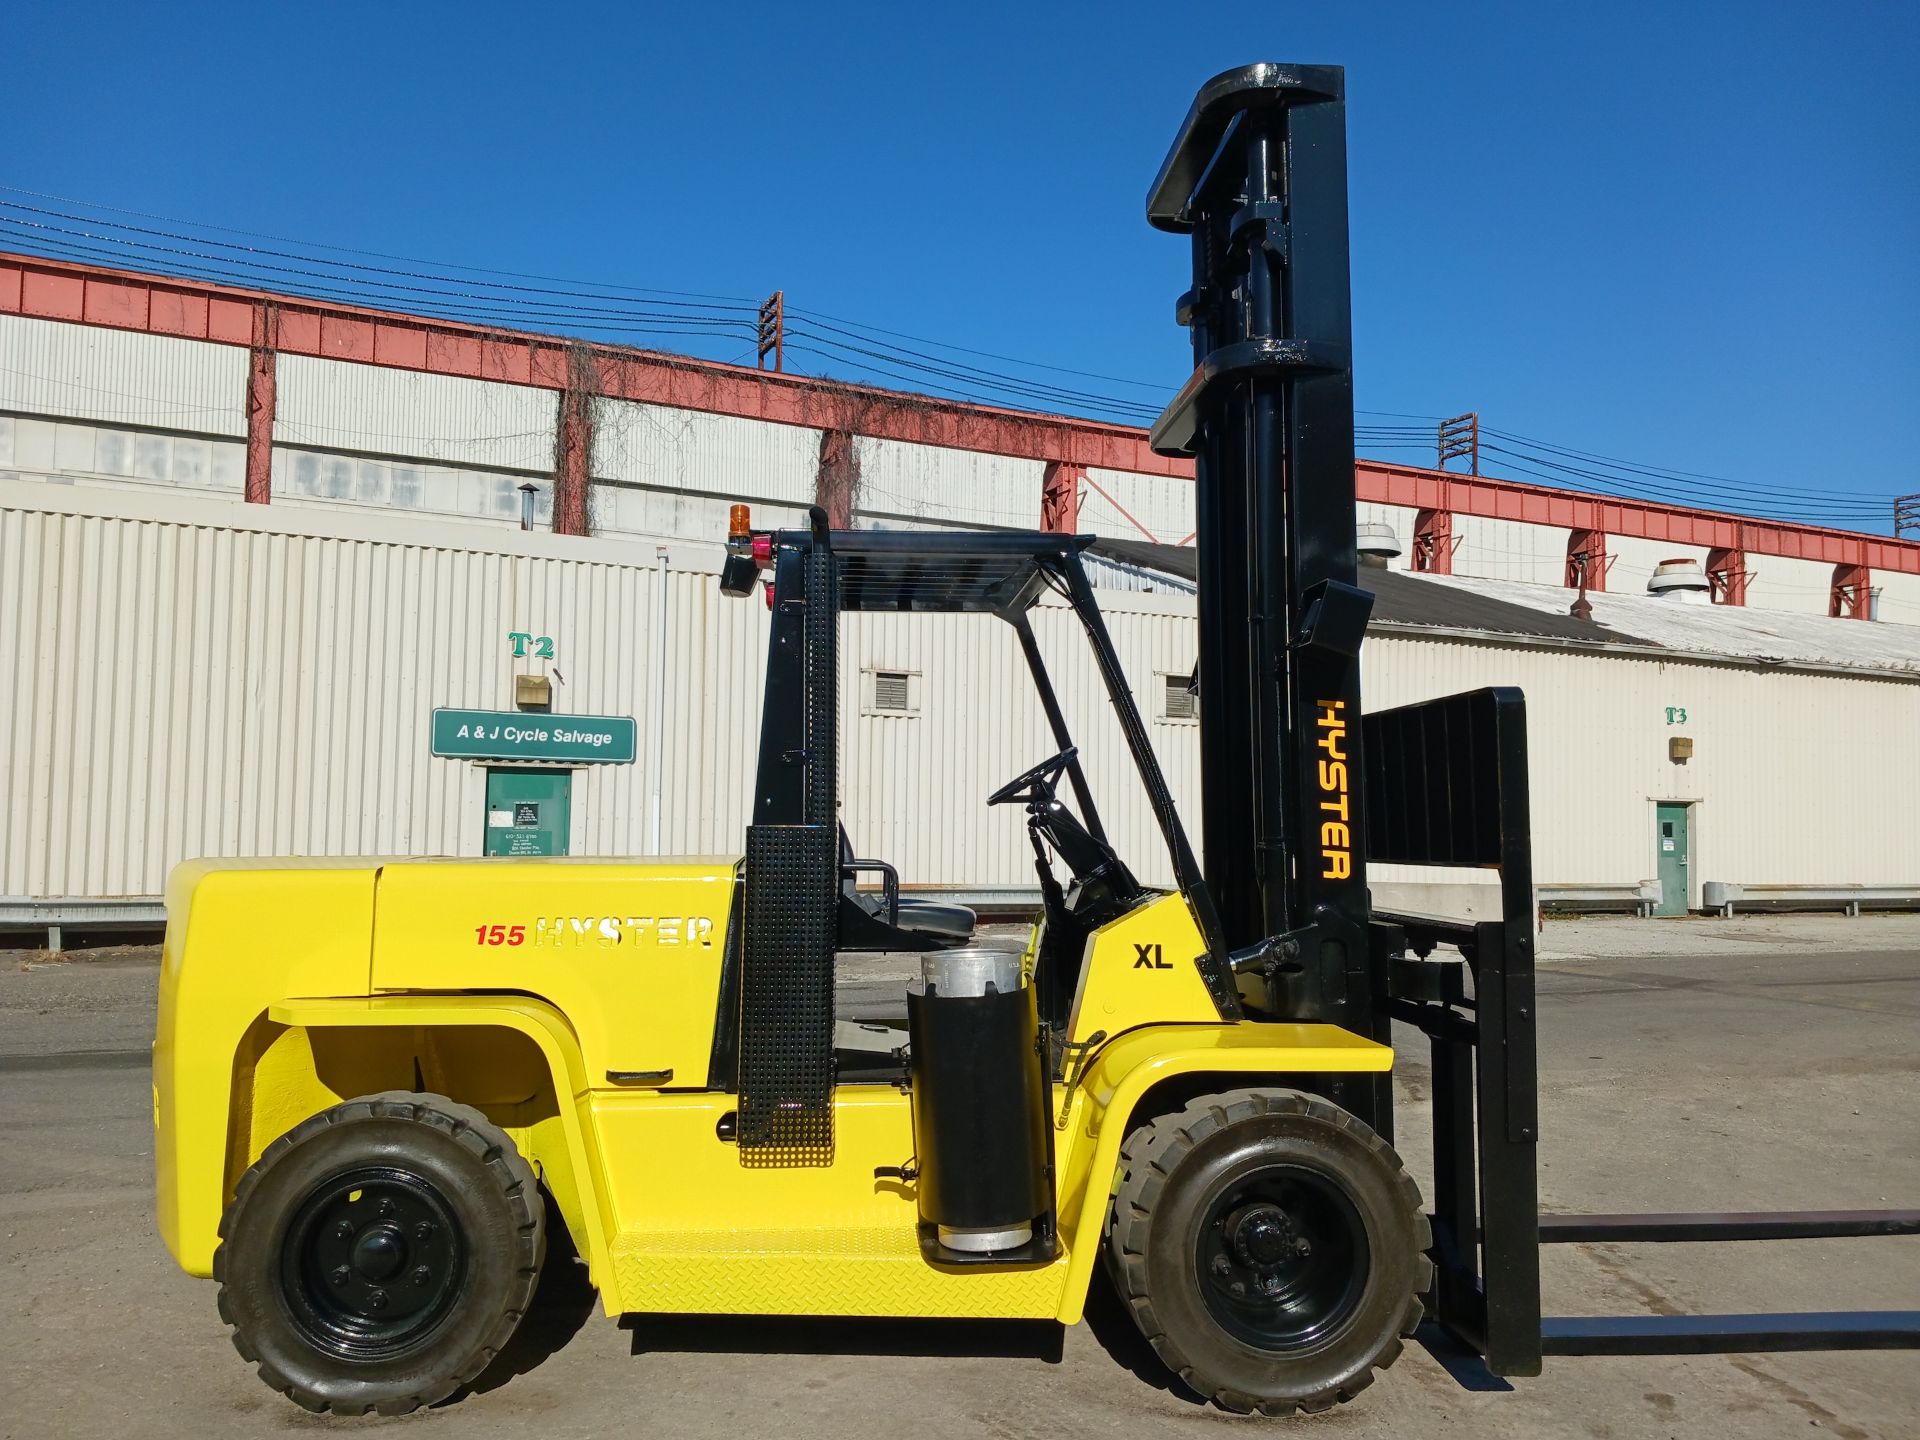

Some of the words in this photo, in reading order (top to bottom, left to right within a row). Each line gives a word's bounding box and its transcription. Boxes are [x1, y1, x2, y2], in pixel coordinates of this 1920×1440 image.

[508, 631, 554, 659] T2
[1665, 706, 1687, 724] T3
[457, 725, 469, 738] A
[474, 726, 485, 739] &
[490, 726, 500, 739] J
[504, 726, 548, 744] Cycle
[553, 729, 612, 746] Salvage
[1317, 699, 1350, 880] HYSTER
[475, 924, 526, 946] 155
[535, 916, 713, 949] HYSTER
[1133, 944, 1173, 968] XL
